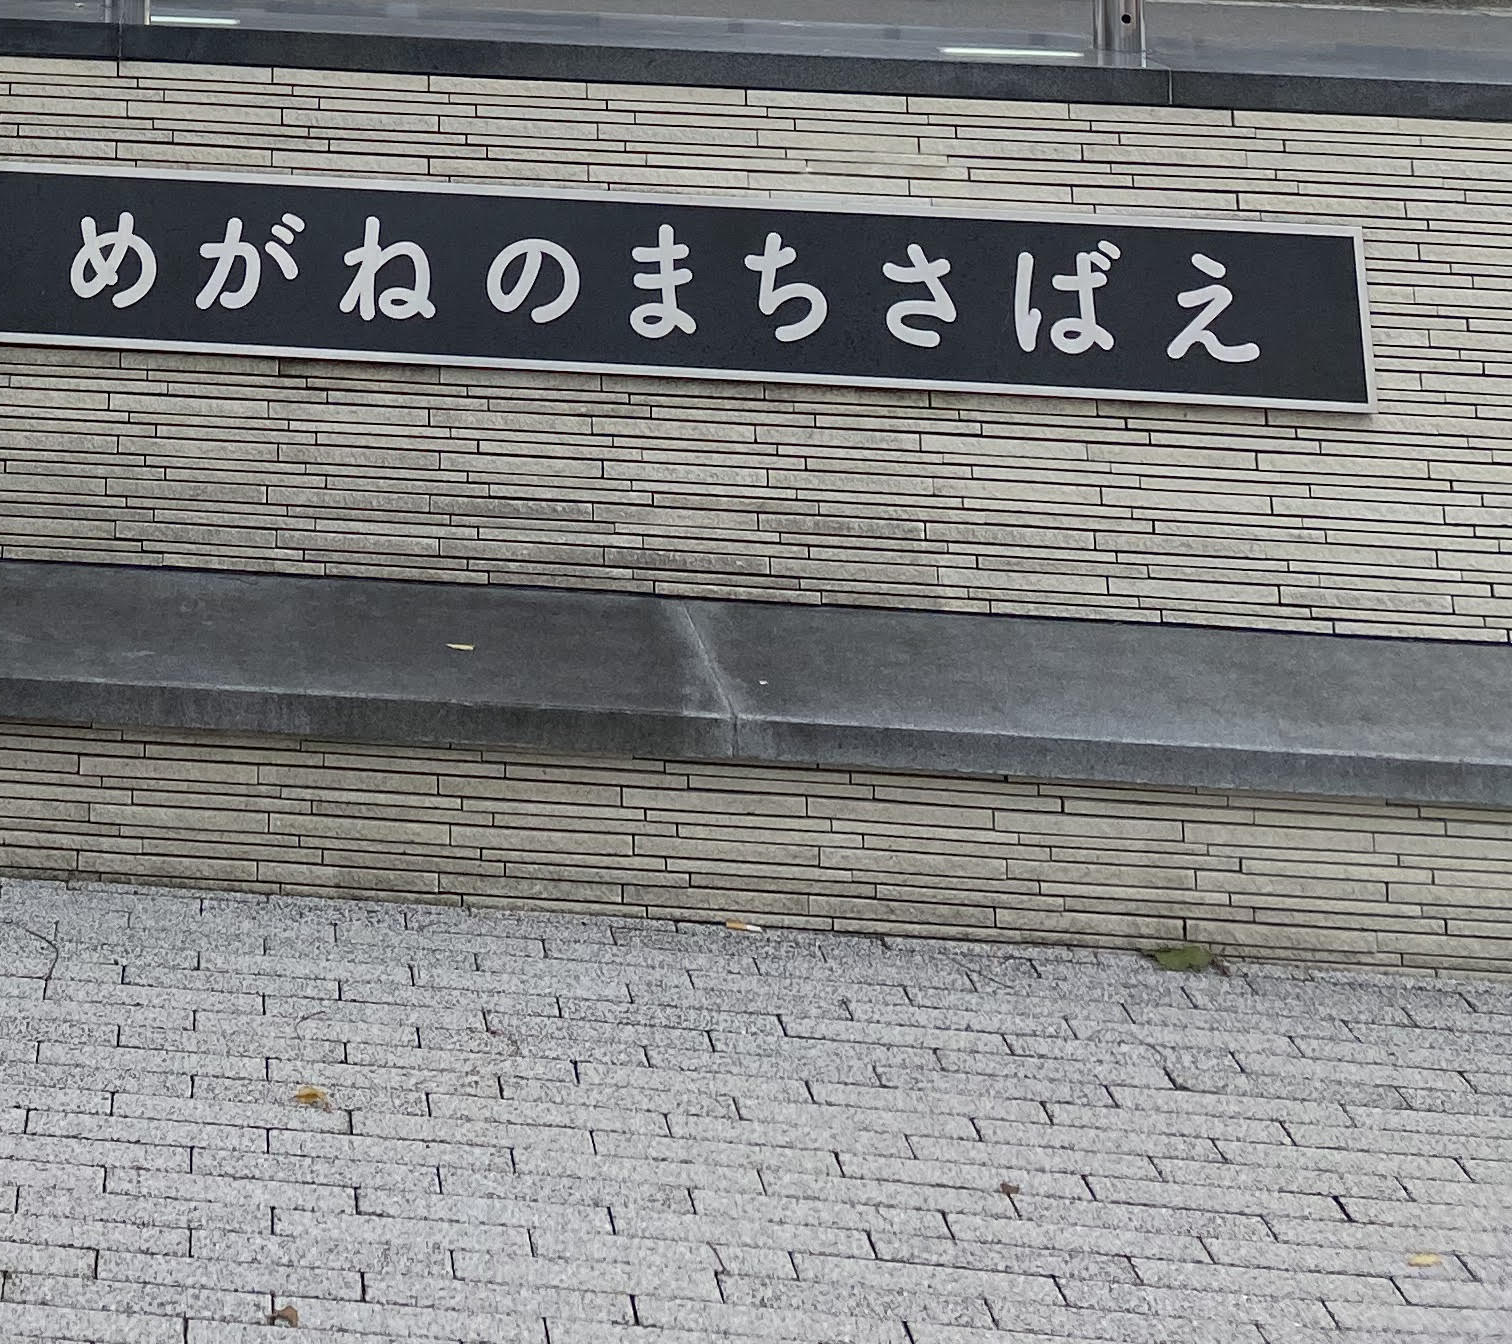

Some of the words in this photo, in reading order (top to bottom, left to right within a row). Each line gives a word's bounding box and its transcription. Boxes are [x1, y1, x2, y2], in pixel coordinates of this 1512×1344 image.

[68, 210, 1263, 363] めがねのまちさばえ
